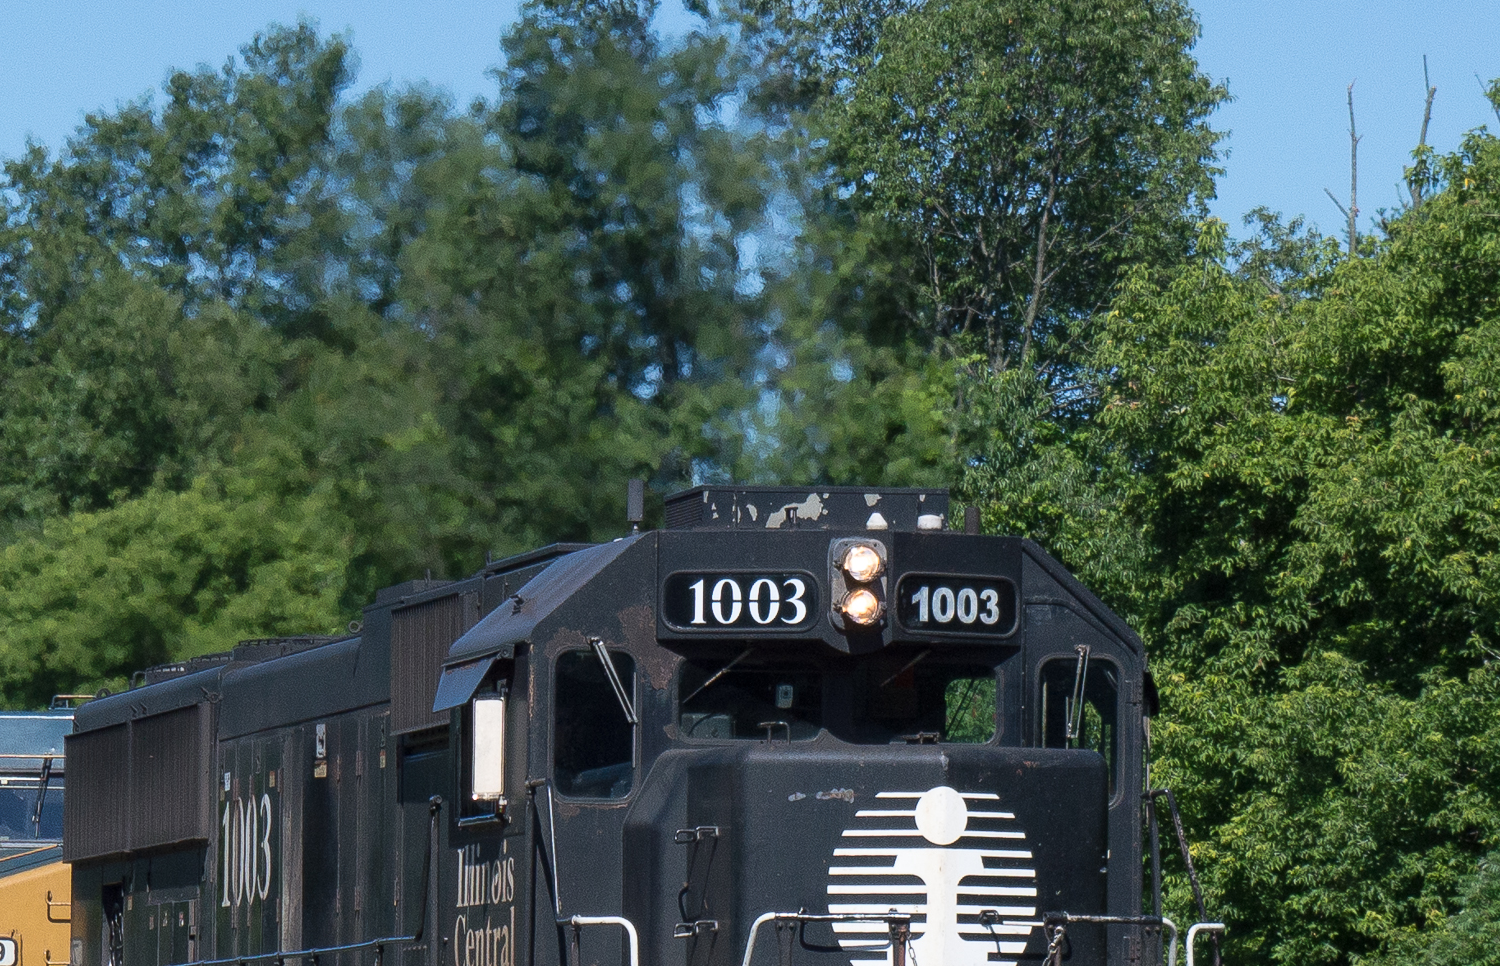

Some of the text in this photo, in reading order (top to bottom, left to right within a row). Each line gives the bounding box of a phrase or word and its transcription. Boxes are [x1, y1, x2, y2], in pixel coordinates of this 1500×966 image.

[688, 578, 807, 625] 1003
[911, 586, 1000, 625] 1003
[221, 793, 272, 908] 1003
[456, 838, 515, 908] Illinois
